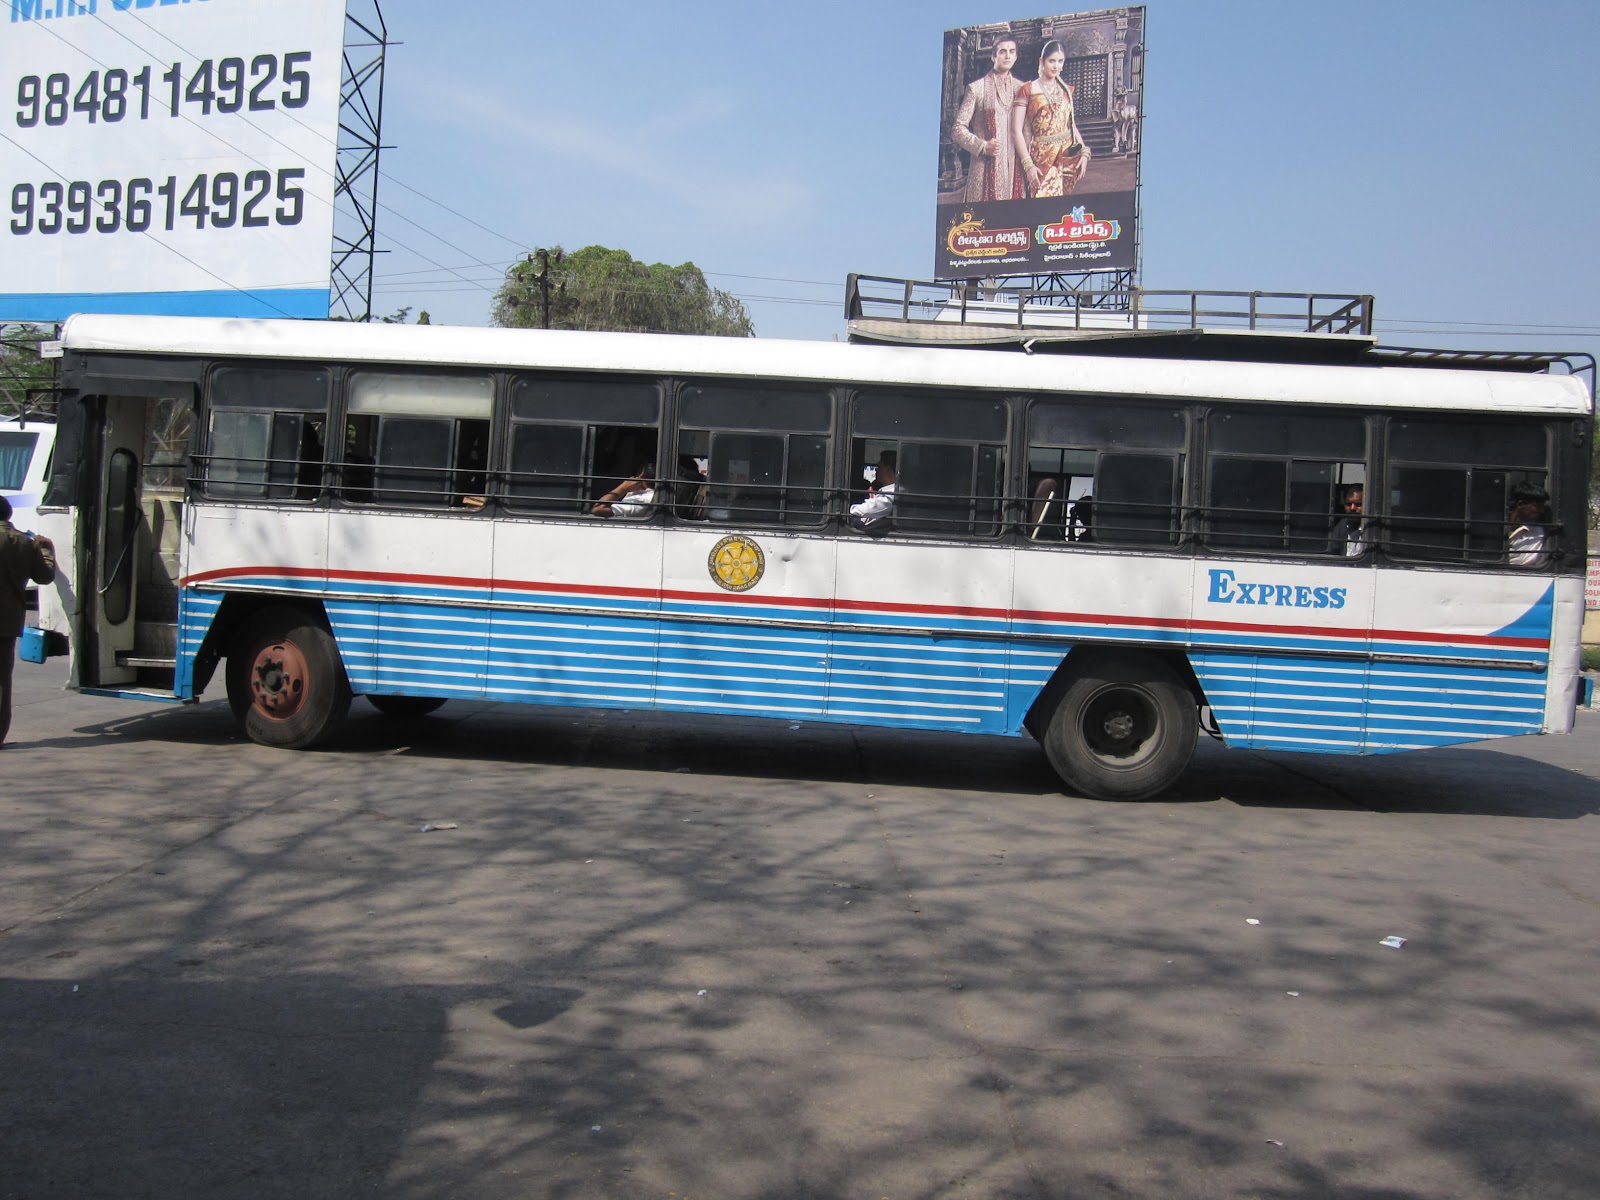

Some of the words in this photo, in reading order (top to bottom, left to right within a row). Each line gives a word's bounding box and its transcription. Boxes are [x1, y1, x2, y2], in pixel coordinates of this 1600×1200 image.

[16, 51, 312, 128] 9848114925
[10, 168, 305, 236] 9393614925
[1046, 227, 1067, 238] R.S.
[1208, 569, 1347, 609] EXPRESS
